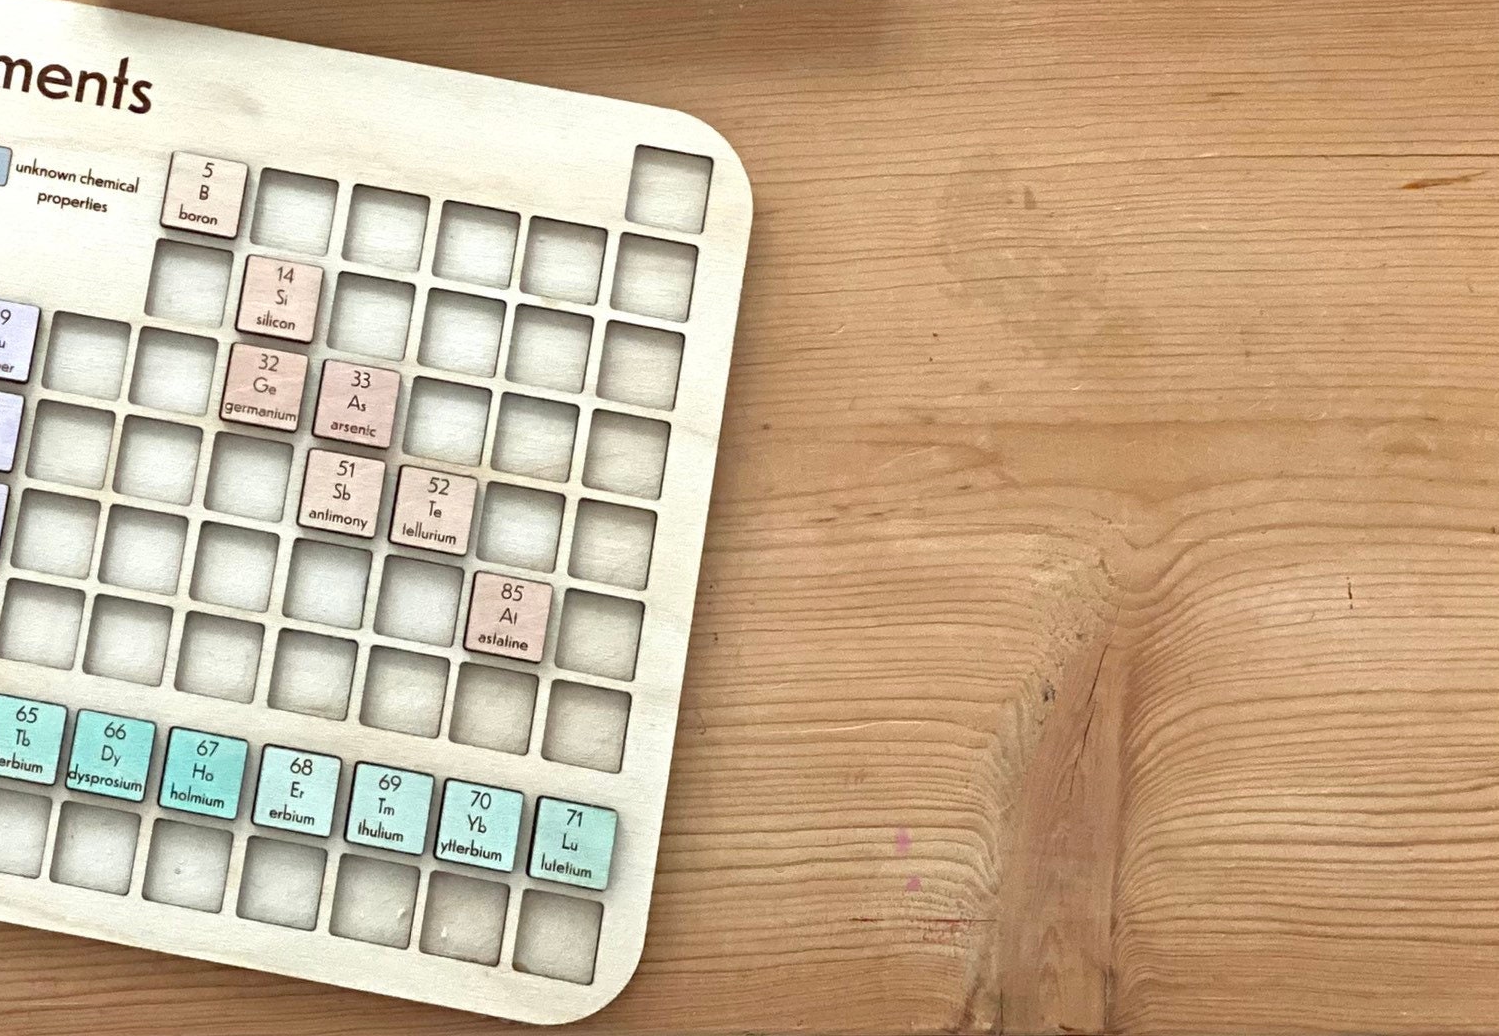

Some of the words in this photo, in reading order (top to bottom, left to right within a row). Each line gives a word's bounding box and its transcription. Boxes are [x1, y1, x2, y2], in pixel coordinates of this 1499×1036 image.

[15, 160, 77, 184] unknown
[79, 169, 139, 194] chemical
[201, 161, 216, 179] 5
[36, 189, 108, 213] properties
[198, 183, 211, 201] B
[177, 203, 219, 226] boron
[276, 265, 295, 285] 14
[274, 288, 289, 307] Si
[255, 309, 296, 331] silicon
[350, 369, 372, 390] 33
[346, 394, 367, 413] As
[329, 420, 377, 438] arsenic
[196, 739, 220, 758] 67
[191, 762, 215, 782] Ho
[289, 756, 314, 777] 68
[169, 785, 225, 810] holmium
[289, 780, 305, 800] Er
[268, 803, 316, 827] erbium
